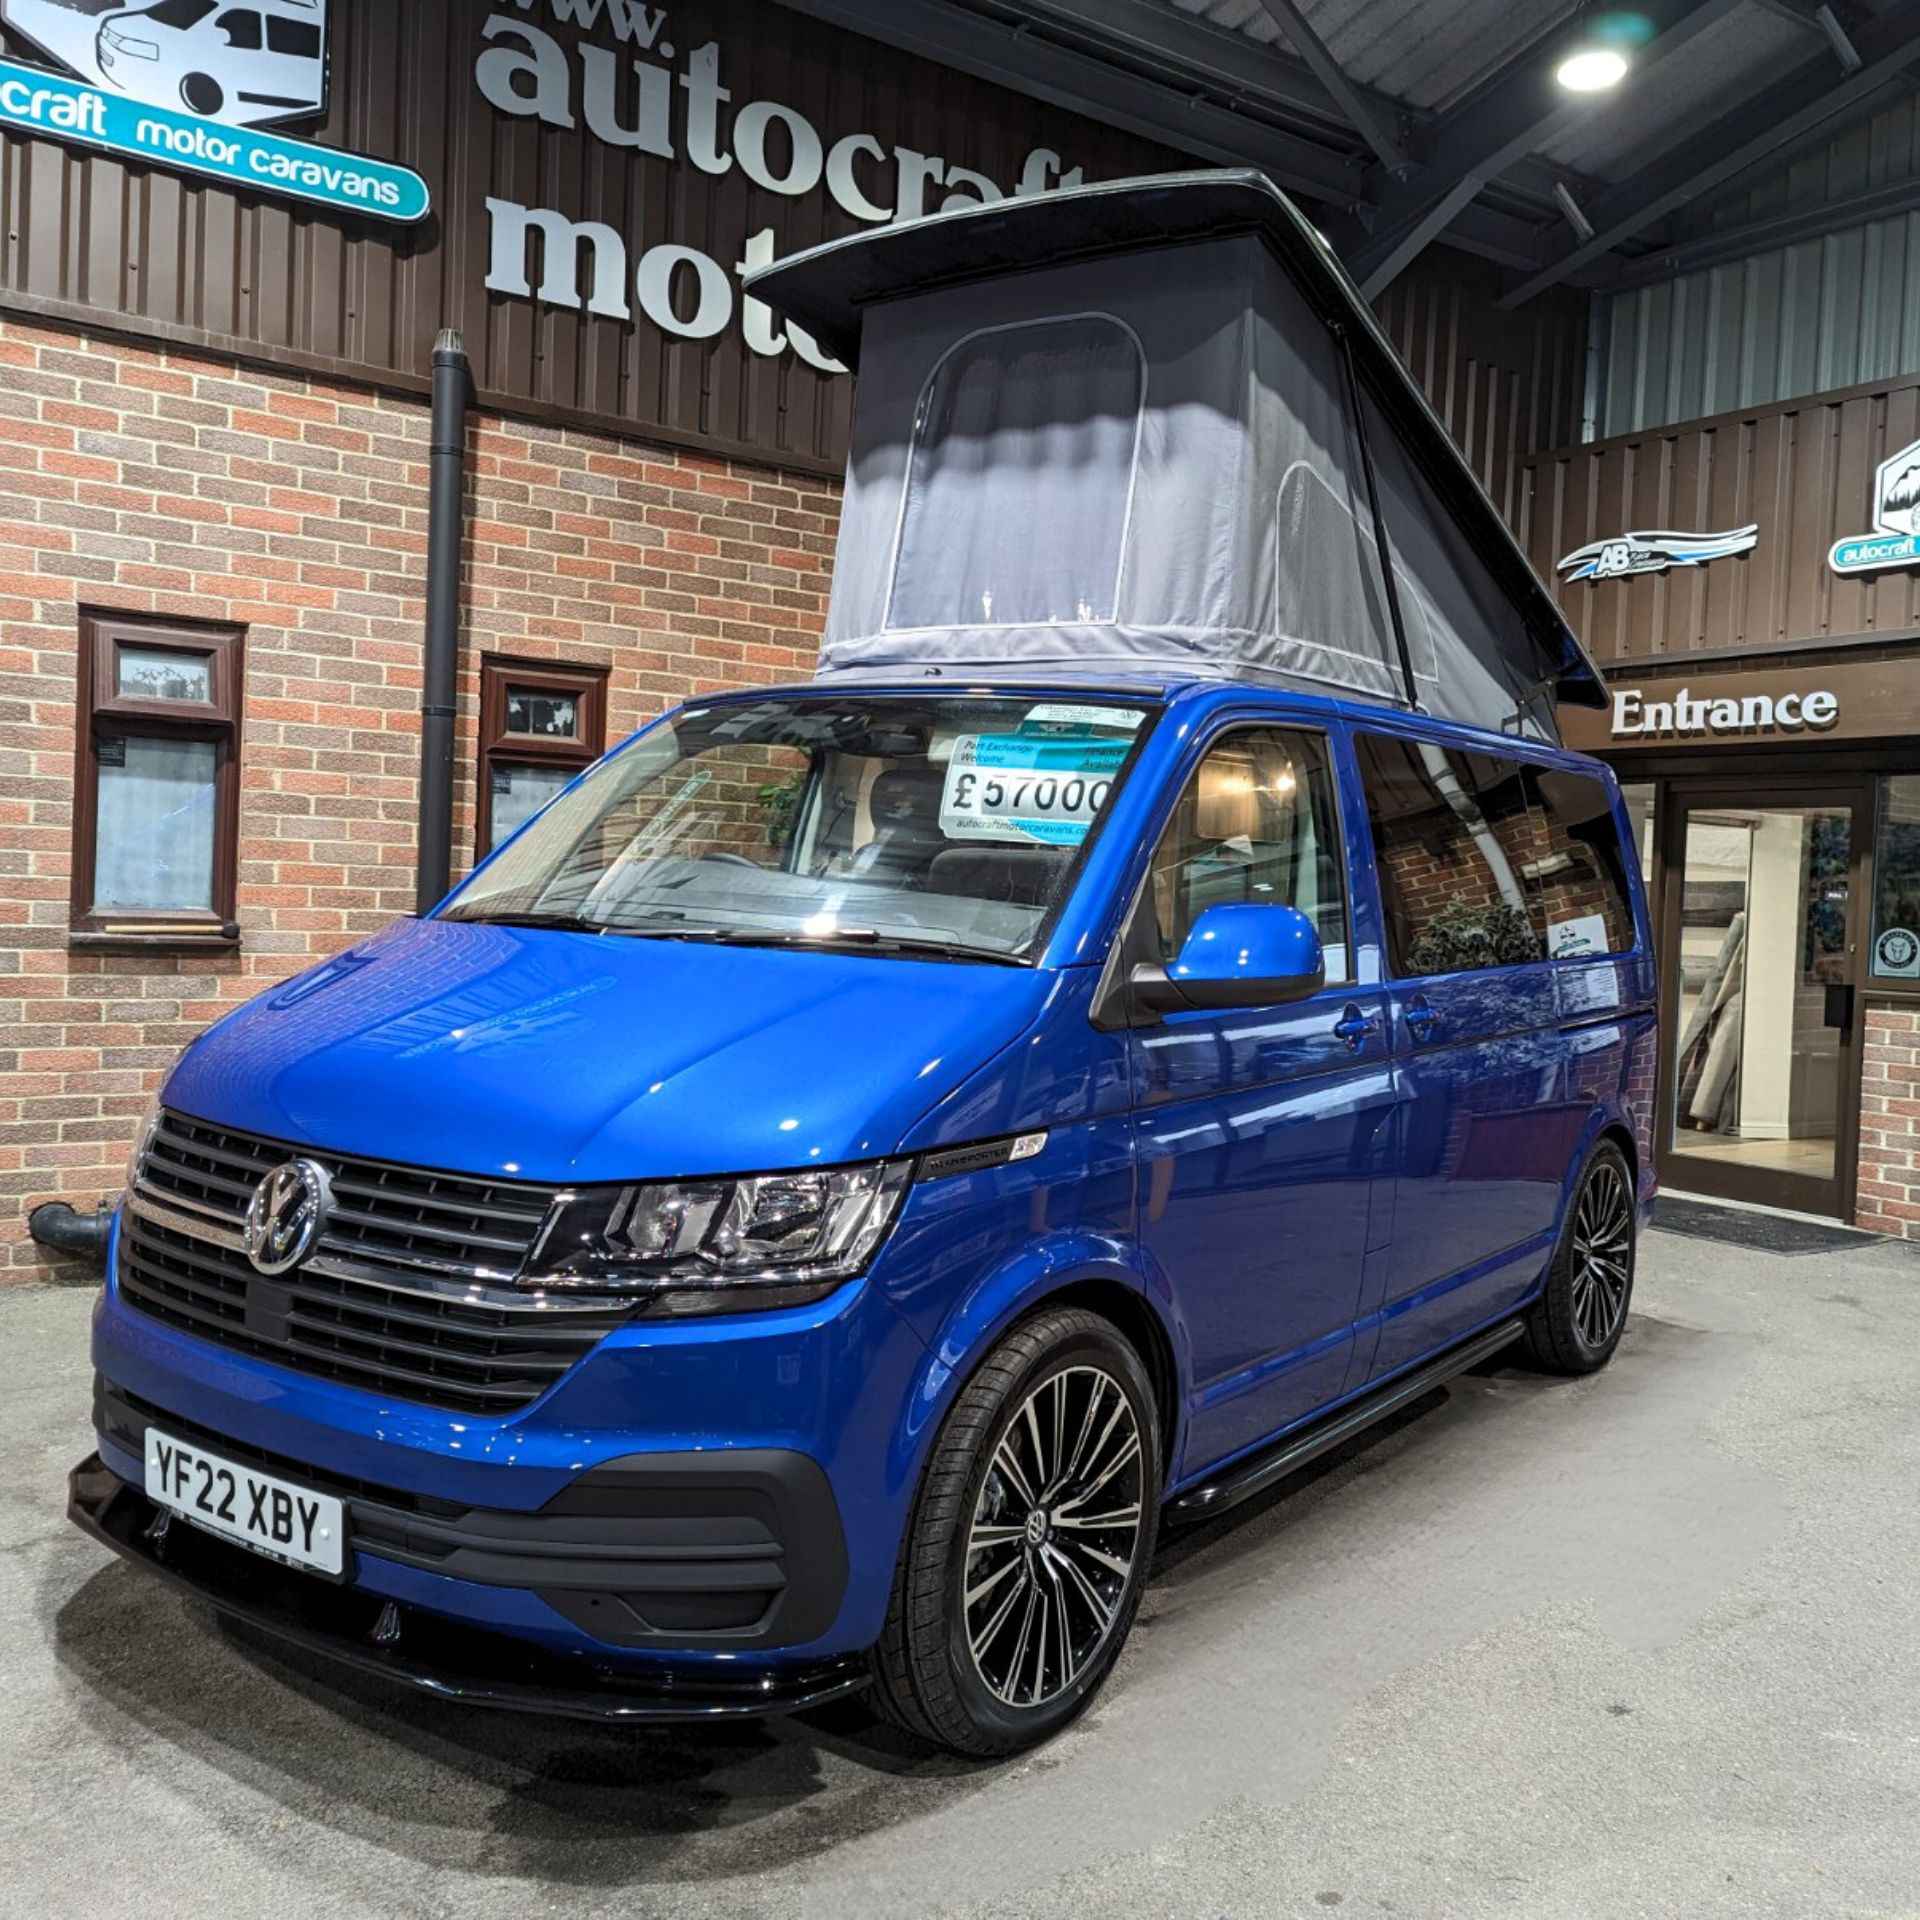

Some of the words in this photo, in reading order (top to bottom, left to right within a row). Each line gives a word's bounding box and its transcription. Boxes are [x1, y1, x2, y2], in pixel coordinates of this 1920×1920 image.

[502, 0, 676, 59] ww.
[136, 118, 242, 166] motor
[248, 148, 401, 206] caravans
[1597, 544, 1630, 574] AB
[1843, 538, 1916, 562] autocraft
[1611, 687, 1838, 734] Entrance
[987, 742, 1034, 754] Exchange
[156, 1440, 236, 1524] YF22
[247, 1478, 319, 1553] XBY
